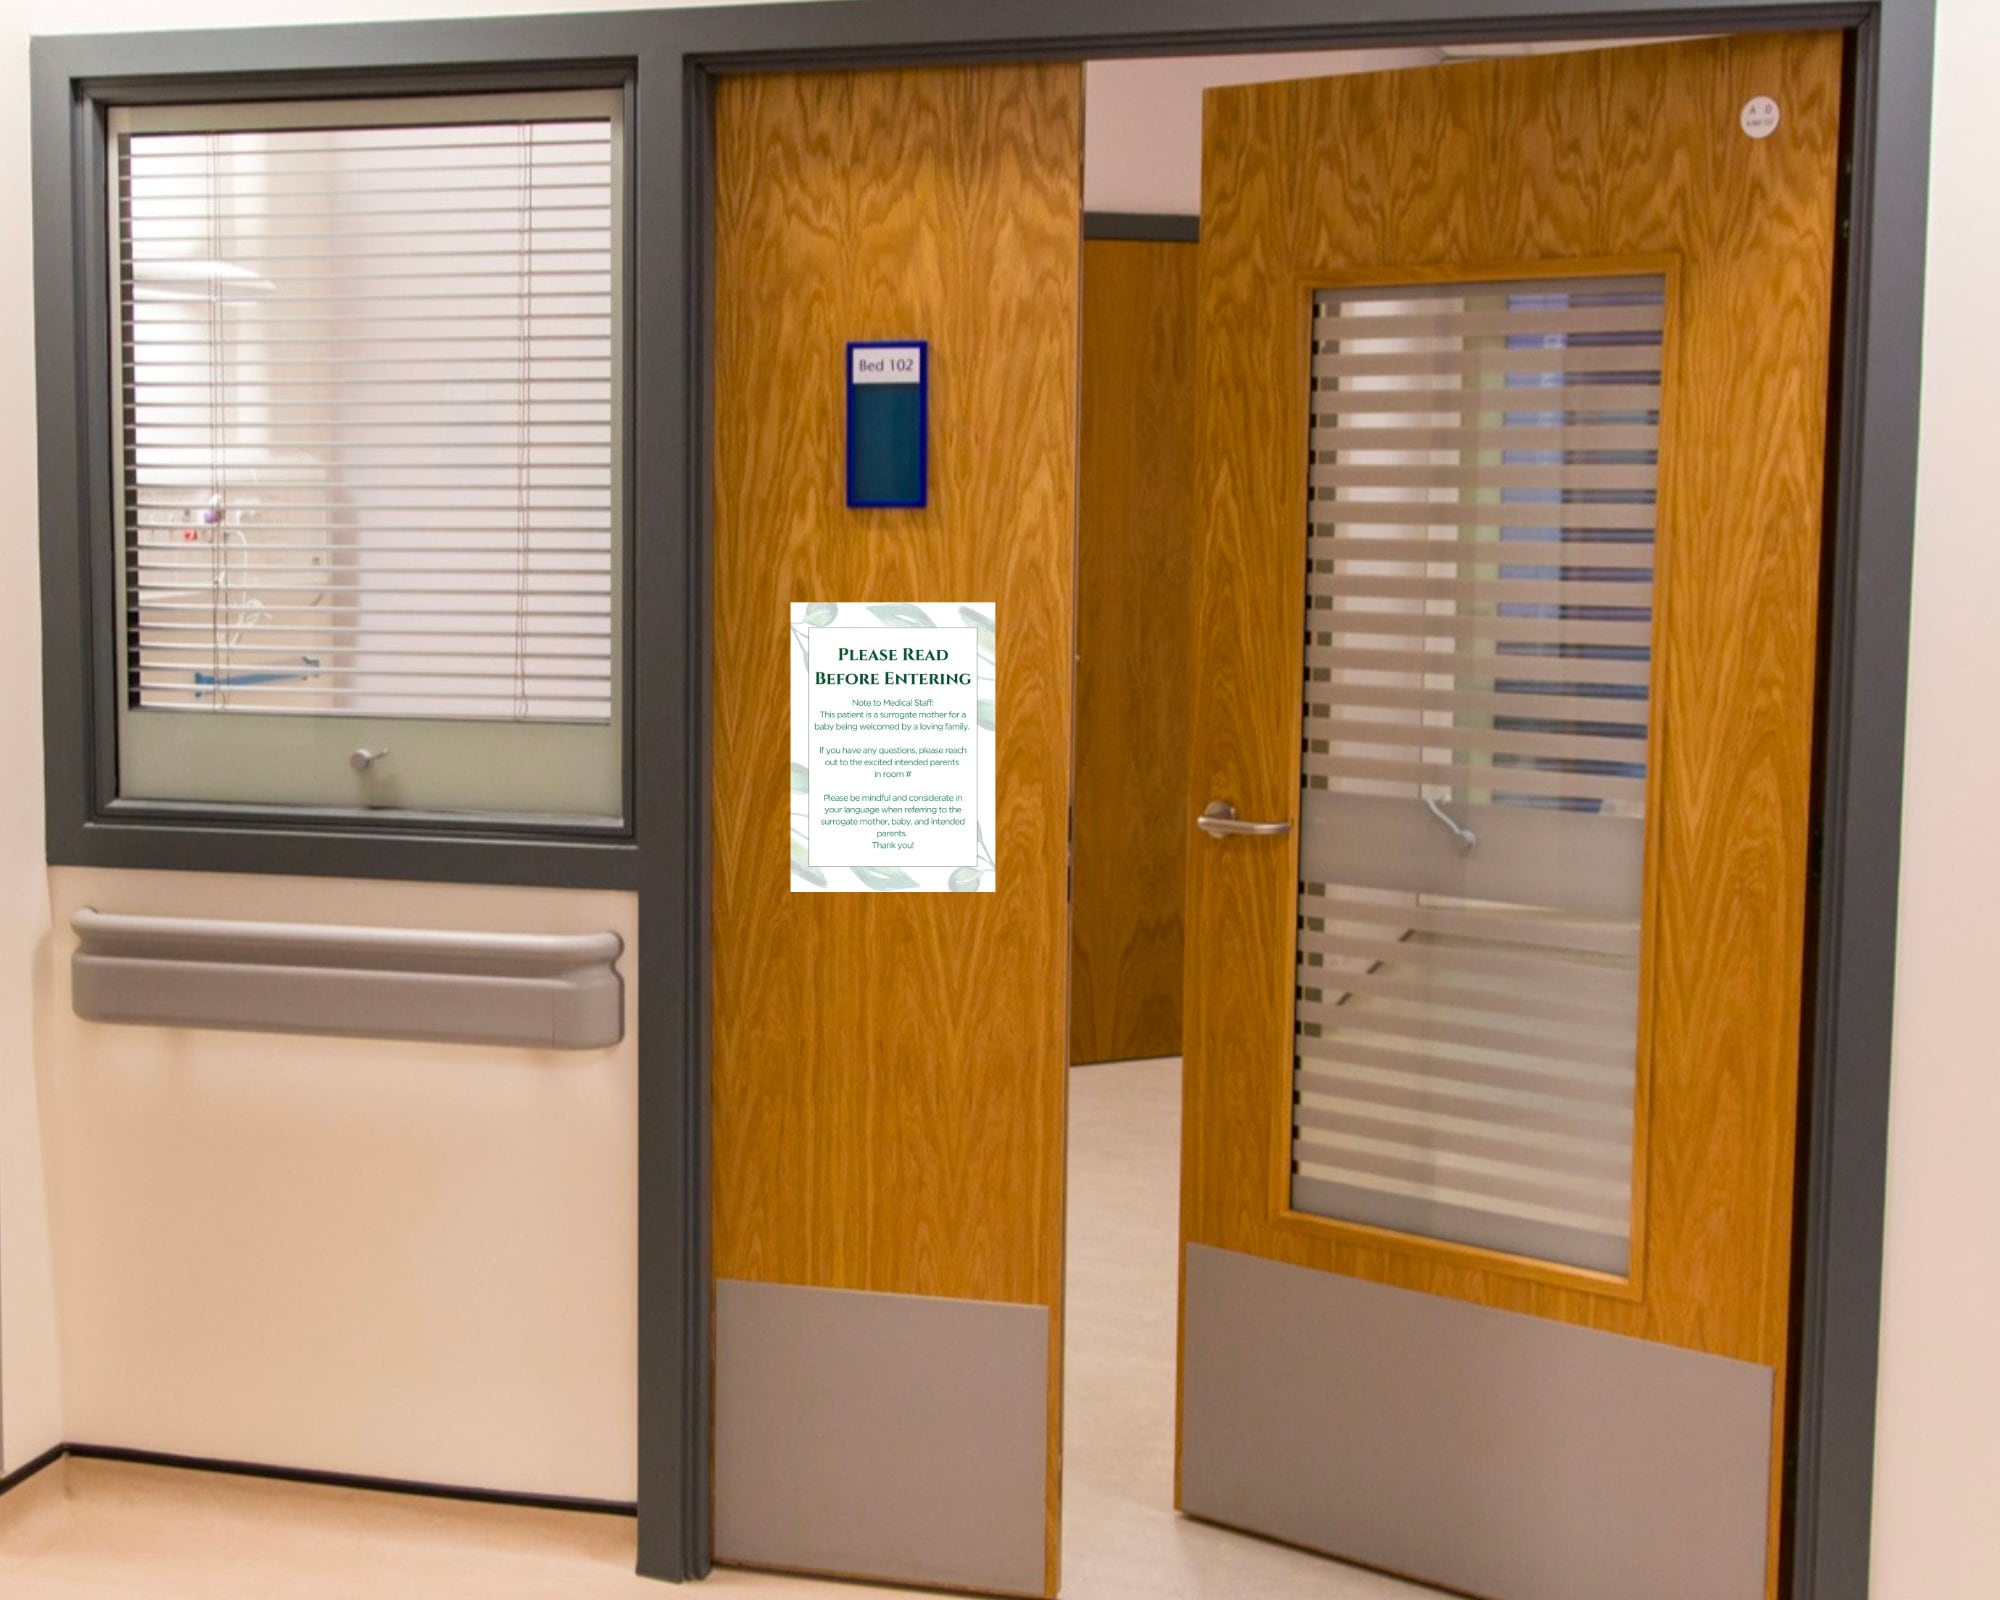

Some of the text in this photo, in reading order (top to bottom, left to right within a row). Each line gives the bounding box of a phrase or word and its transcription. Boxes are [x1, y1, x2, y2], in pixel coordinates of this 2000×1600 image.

[858, 358, 914, 372] Bed 102
[838, 647, 949, 662] PLEASE READ
[815, 671, 972, 686] BEFORE ENTERING
[851, 698, 934, 707] Note to Medical Staff:
[819, 710, 836, 719] This
[836, 711, 865, 720] patient
[879, 711, 918, 720] surrogate
[918, 711, 948, 719] mother
[947, 710, 961, 719] for
[814, 722, 835, 732] baby
[835, 722, 858, 732] being
[859, 722, 900, 731] welcomed
[901, 722, 912, 732] by
[919, 722, 944, 732] loving
[944, 722, 970, 732] family.
[819, 746, 968, 756] If you have any questions, please reach
[824, 758, 960, 768] out to the excited intended parents
[874, 770, 882, 778] in
[905, 770, 912, 778] #
[823, 793, 849, 802] Please
[849, 794, 861, 802] be
[861, 793, 891, 802] mindful
[891, 794, 908, 802] and
[908, 793, 955, 802] considerate
[824, 805, 962, 815] your language when referring to the
[820, 817, 966, 827] surrogate mother, baby, and intended
[876, 830, 907, 839] parents.
[871, 841, 915, 850] Thank you!
